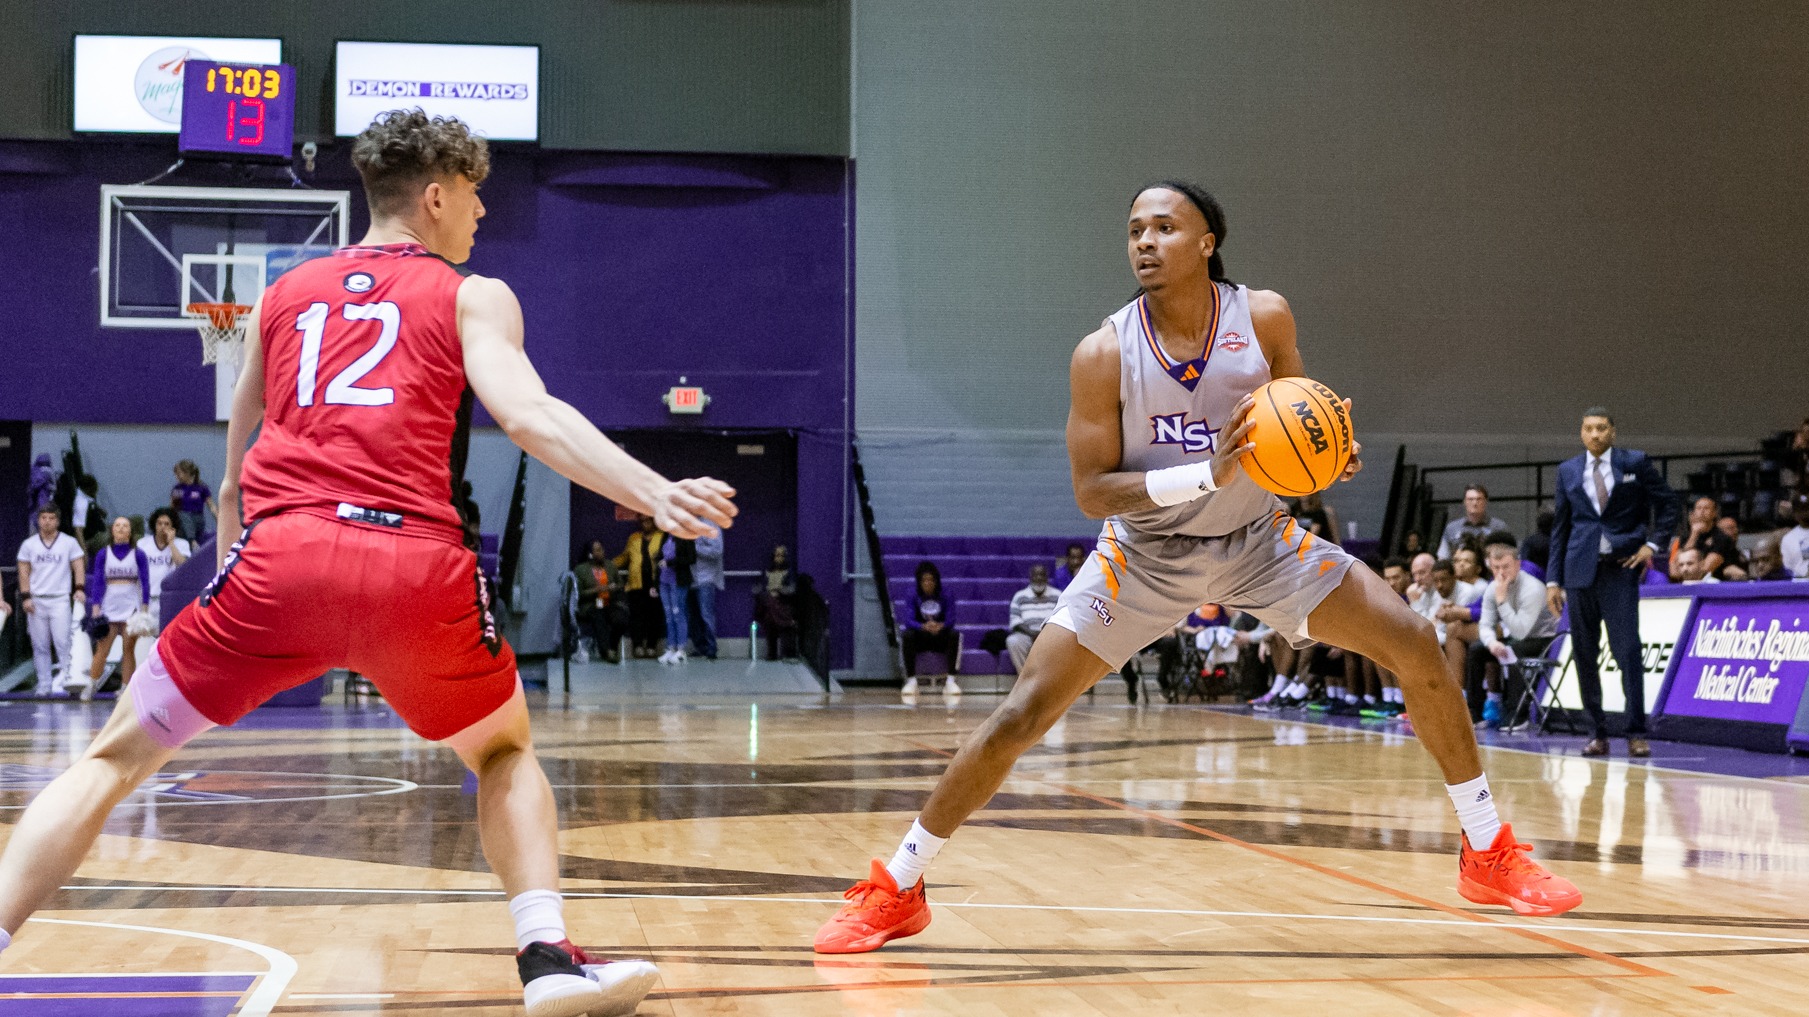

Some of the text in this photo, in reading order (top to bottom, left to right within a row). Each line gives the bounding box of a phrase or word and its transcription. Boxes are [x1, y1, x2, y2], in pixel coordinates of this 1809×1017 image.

[206, 66, 281, 99] 17:03
[348, 80, 529, 101] DEMON REWARDS
[225, 97, 266, 146] 13
[295, 300, 401, 407] 12
[675, 388, 698, 407] EXIT
[1290, 400, 1330, 456] NCAA
[36, 553, 62, 565] NSU
[108, 567, 133, 576] NSU
[148, 555, 173, 567] NSU
[1090, 597, 1115, 627] NSU
[1688, 615, 1765, 660] Natchitoches
[1693, 664, 1780, 704] Medical Center
